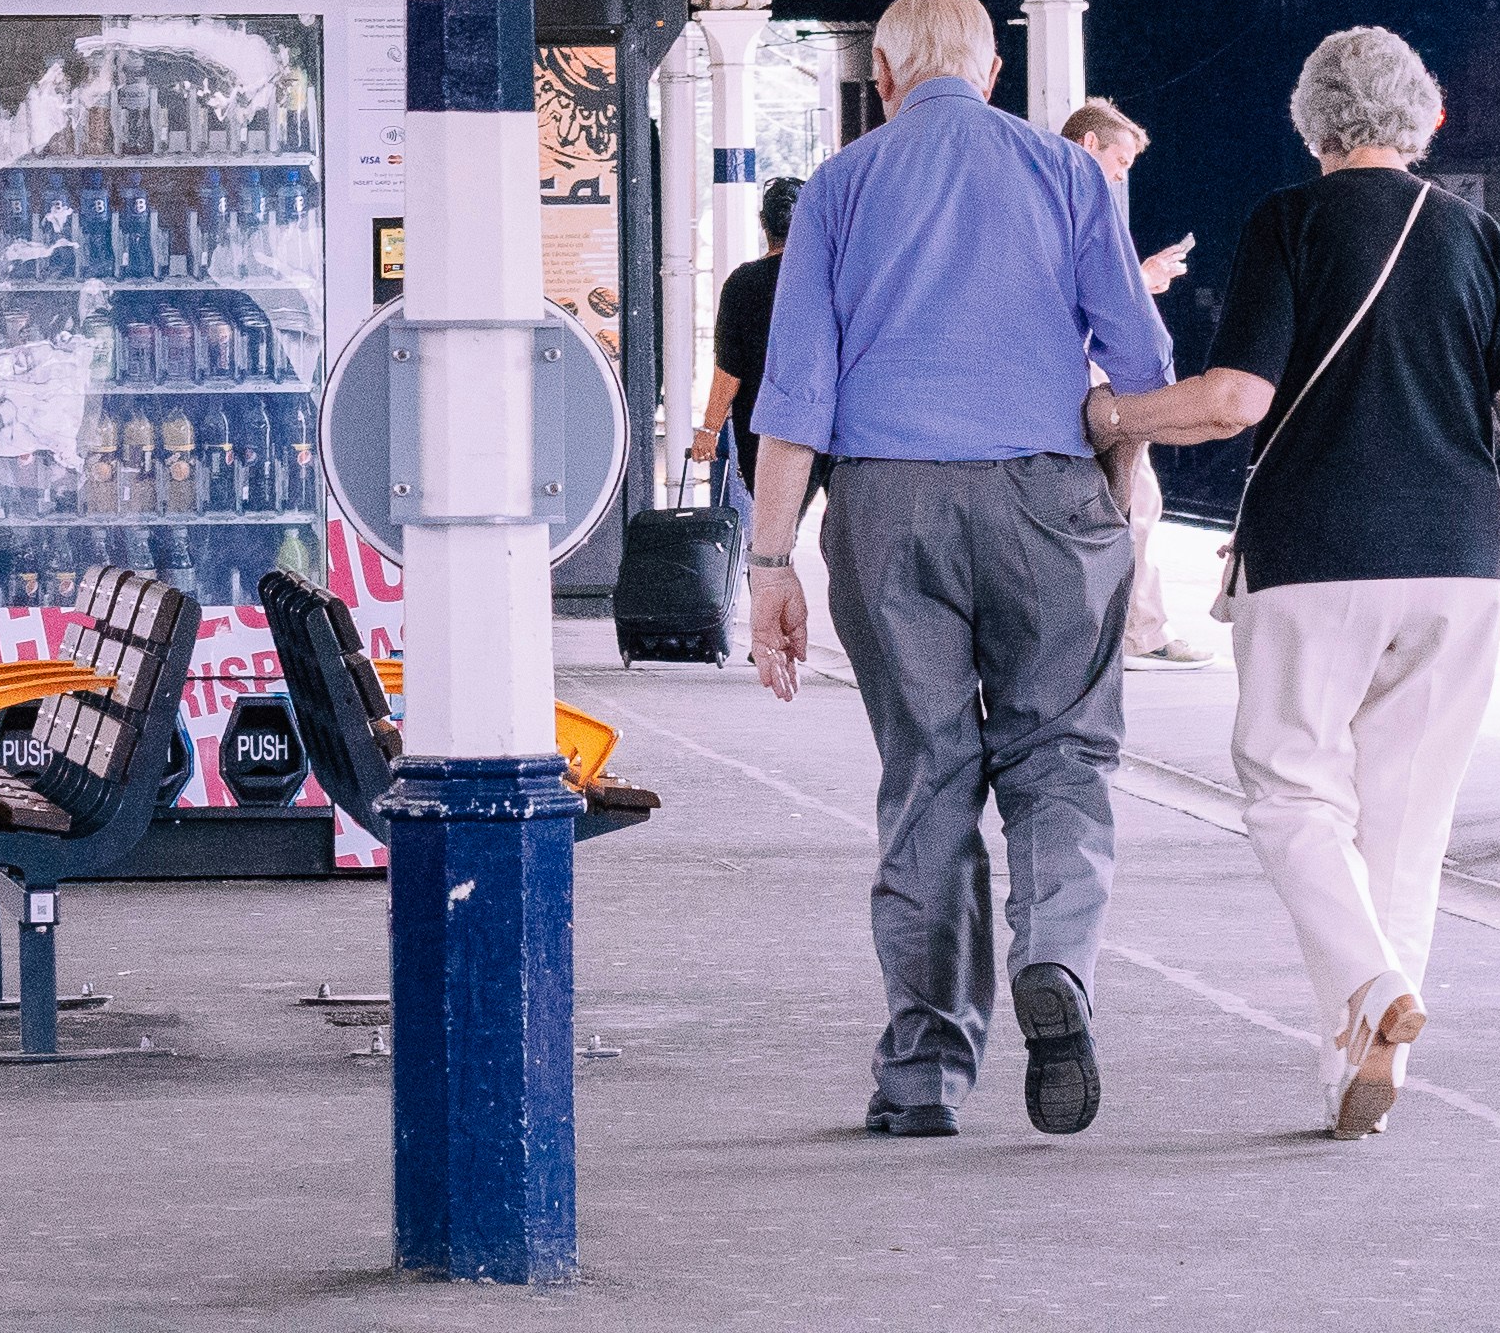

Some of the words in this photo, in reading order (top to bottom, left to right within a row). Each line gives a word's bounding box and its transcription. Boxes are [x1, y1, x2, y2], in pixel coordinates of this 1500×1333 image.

[359, 155, 381, 165] VISA
[1, 738, 53, 767] PUSH
[236, 735, 289, 761] PUSH
